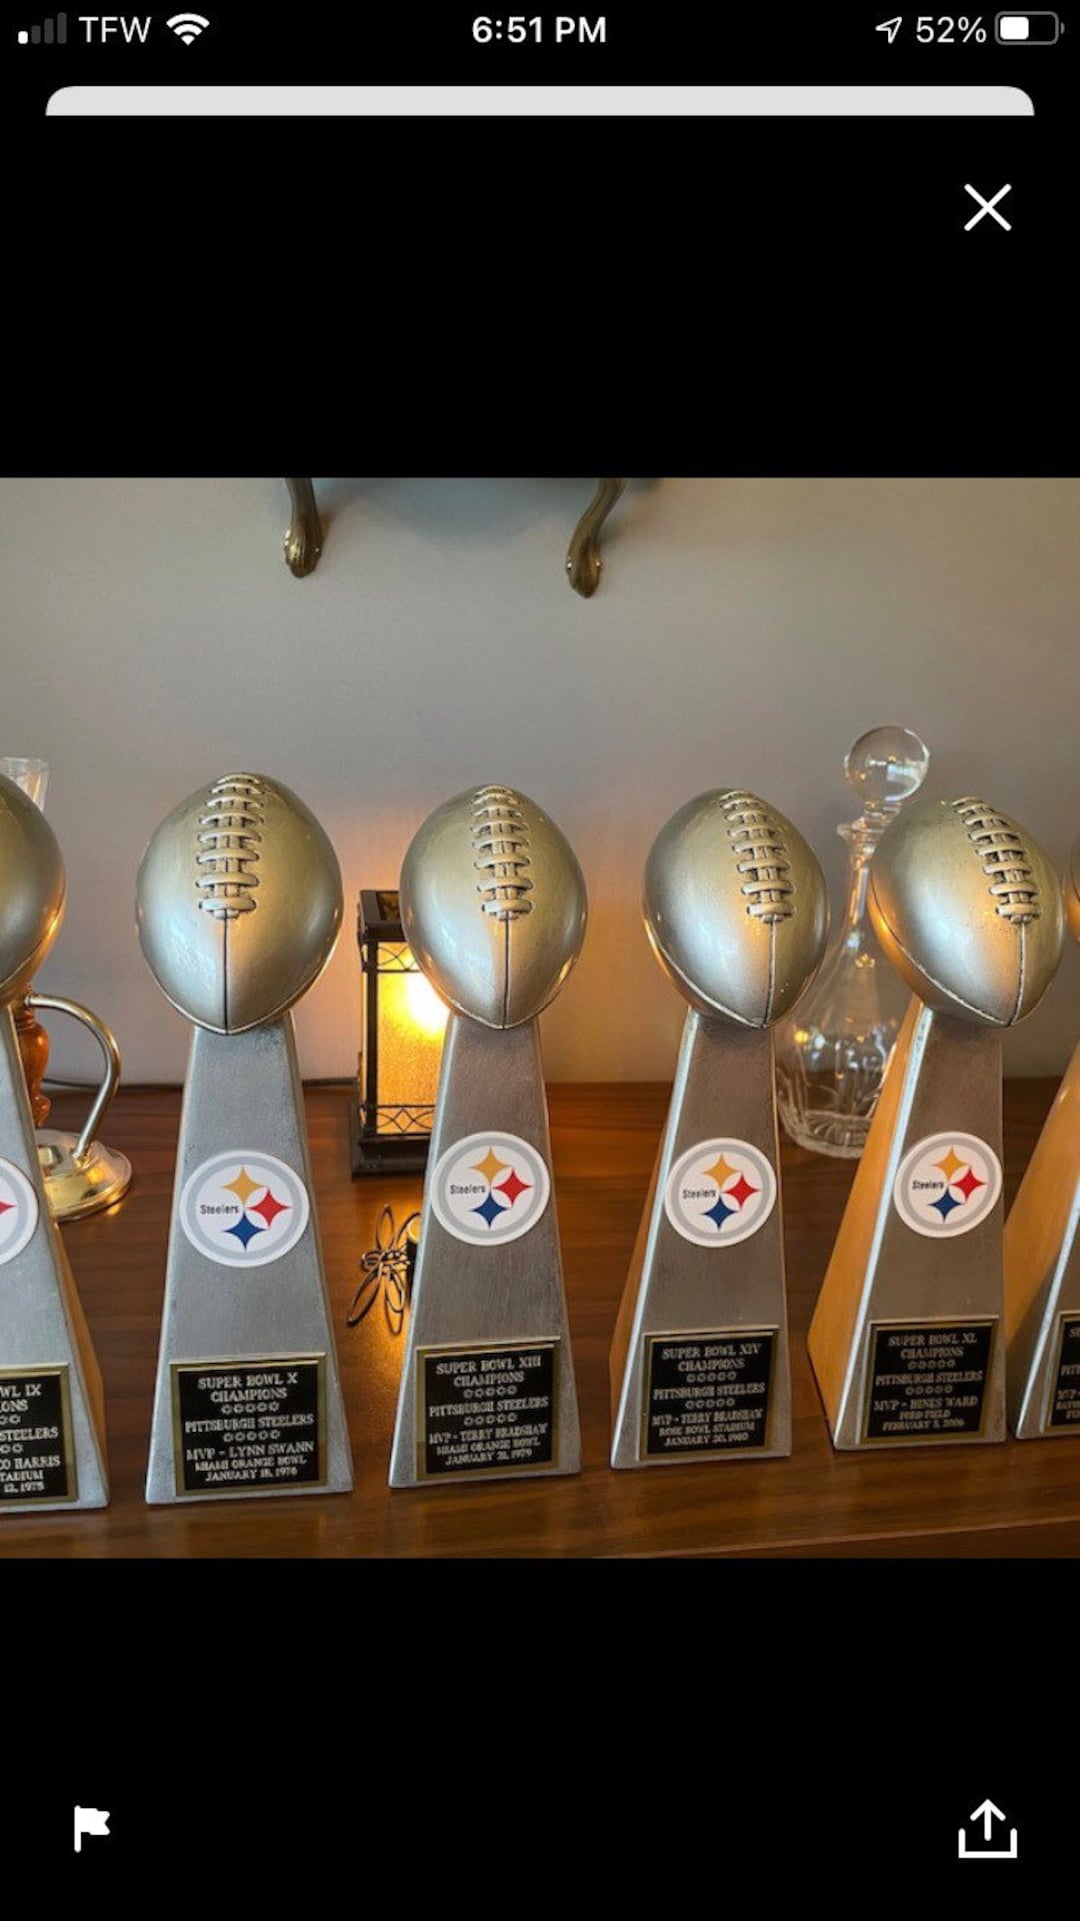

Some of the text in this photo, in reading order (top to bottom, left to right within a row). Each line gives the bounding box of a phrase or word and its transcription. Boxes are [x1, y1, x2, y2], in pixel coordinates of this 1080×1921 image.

[450, 1184, 486, 1196] Steelers
[912, 1179, 945, 1190] Steelers
[682, 1188, 716, 1200] Steelers
[200, 1204, 239, 1216] Steelers
[888, 1335, 925, 1346] SUPER
[929, 1333, 959, 1345] BOWL
[662, 1343, 761, 1360] SUPER BOWL XIV
[901, 1346, 964, 1359] CHAMPIONS
[436, 1356, 541, 1375] SUPER BOWL XIII
[678, 1358, 745, 1372] CHAMPIONS
[198, 1372, 298, 1389] SUPER BOWL X
[454, 1371, 525, 1387] CHAMPIONS
[0, 1384, 41, 1398] WL IX
[211, 1388, 287, 1402] CHAMPIONS
[653, 1382, 766, 1400] PITTSBURGH STEELERS
[0, 1400, 28, 1412] ONS
[429, 1396, 549, 1417] PITTSBURGH STEELERS
[185, 1413, 314, 1433] PITTSBURGH STEELERS
[429, 1433, 450, 1445] MVP
[460, 1428, 493, 1442] TERRY
[186, 1448, 215, 1460] MVP
[229, 1444, 265, 1458] LYNN
[268, 1441, 314, 1455] SWANN
[205, 1470, 257, 1482] JANUARY
